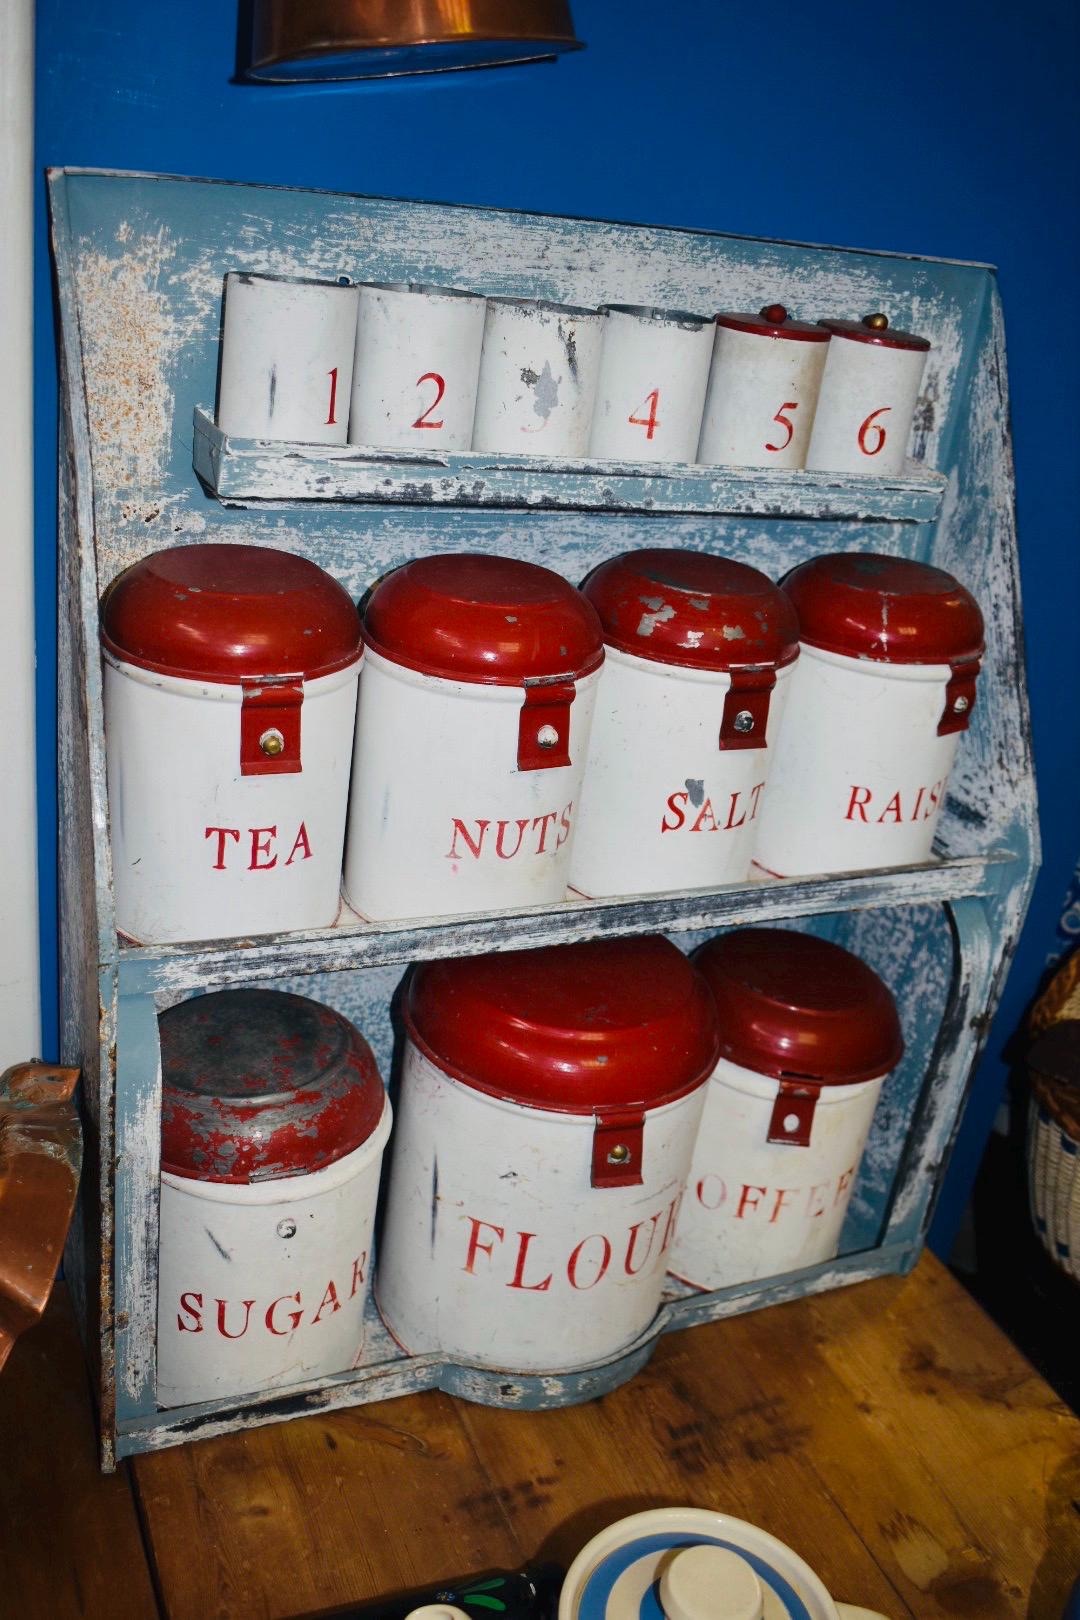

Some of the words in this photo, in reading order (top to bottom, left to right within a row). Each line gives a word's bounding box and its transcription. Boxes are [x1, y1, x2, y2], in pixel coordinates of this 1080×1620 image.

[327, 366, 339, 426] 1
[413, 371, 447, 430] 2
[628, 387, 661, 441] 4
[765, 402, 798, 453] 5
[857, 408, 888, 456] 6
[444, 800, 574, 860] NUTS
[661, 781, 766, 834] SALT
[204, 820, 313, 871] TEA
[177, 1250, 367, 1341] SUGAR
